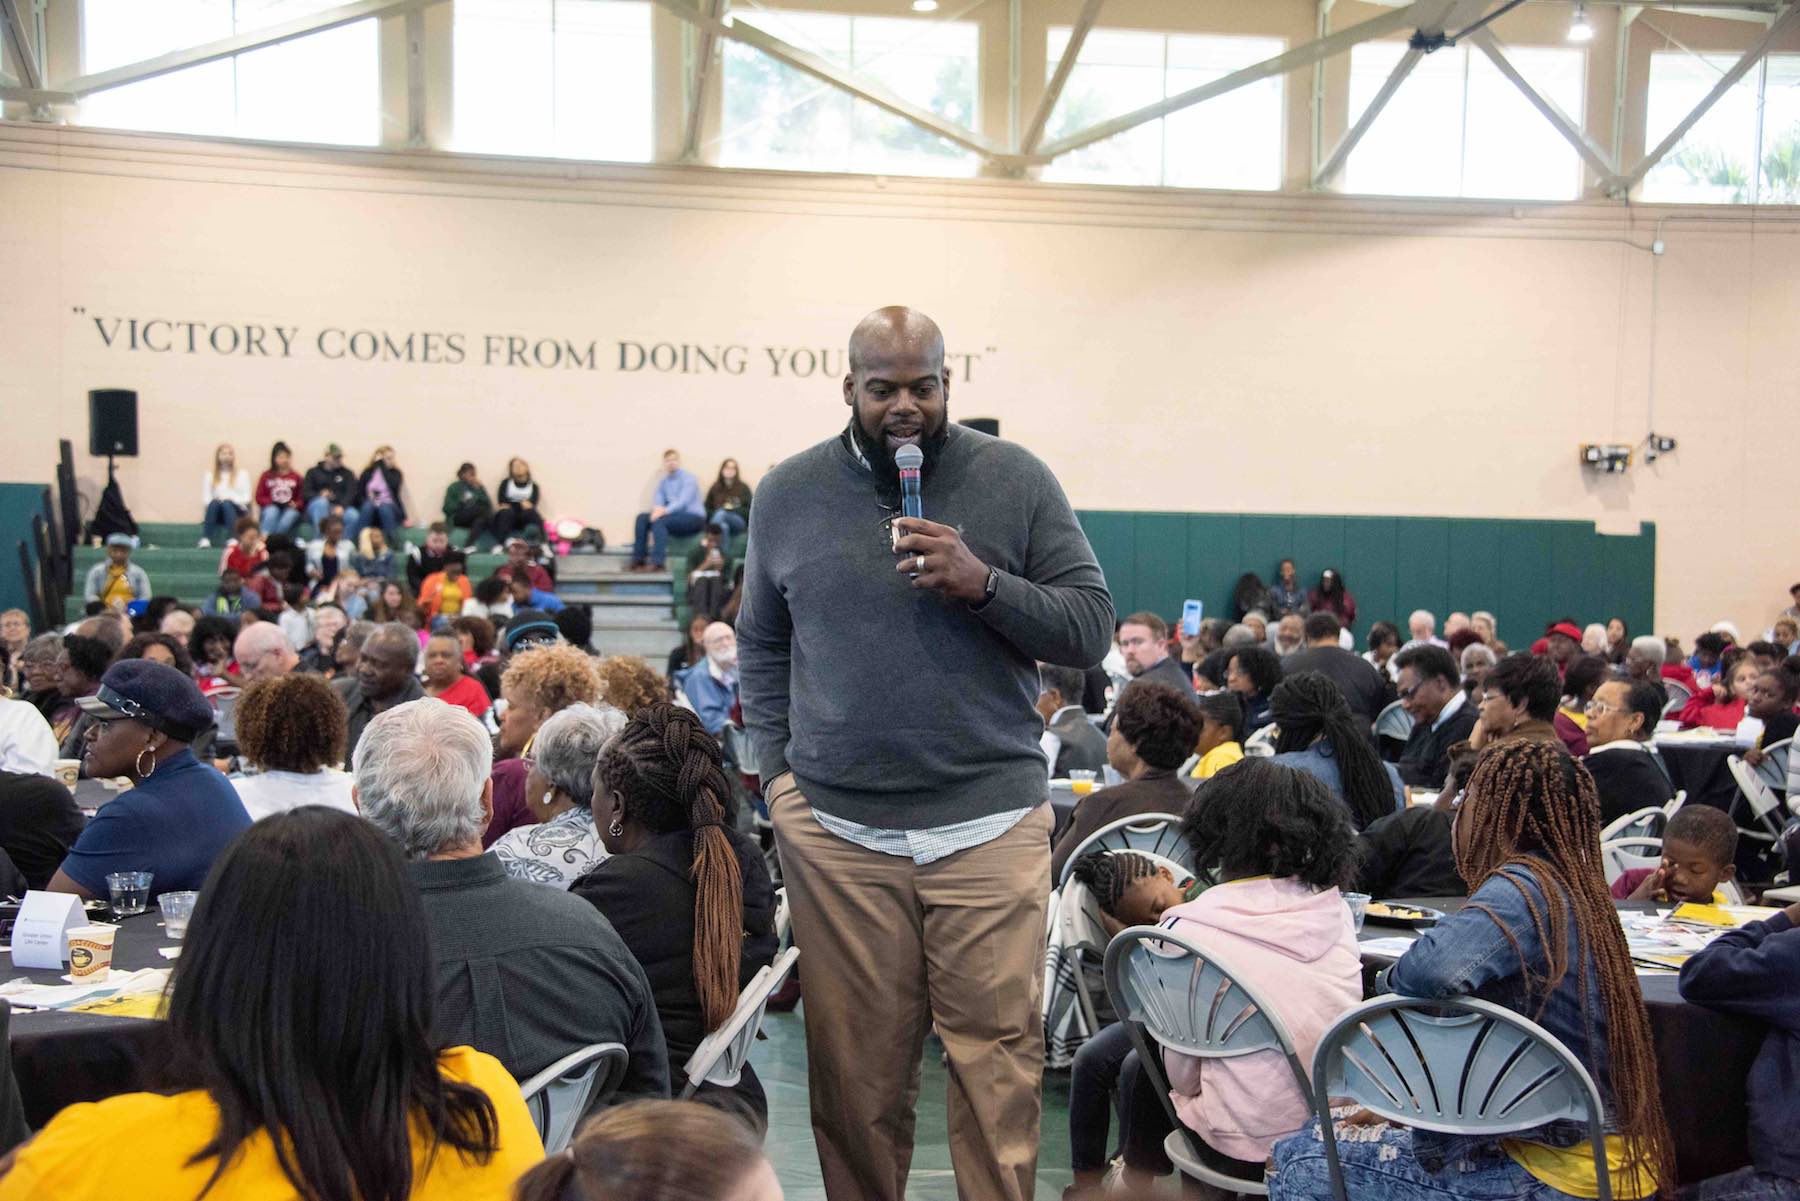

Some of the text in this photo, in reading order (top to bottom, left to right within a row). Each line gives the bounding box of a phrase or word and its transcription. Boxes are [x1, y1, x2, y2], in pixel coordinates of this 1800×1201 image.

[315, 327, 466, 364] COMES
[483, 334, 598, 371] FROM
[616, 340, 748, 377] DOING
[762, 346, 847, 379] YOU
